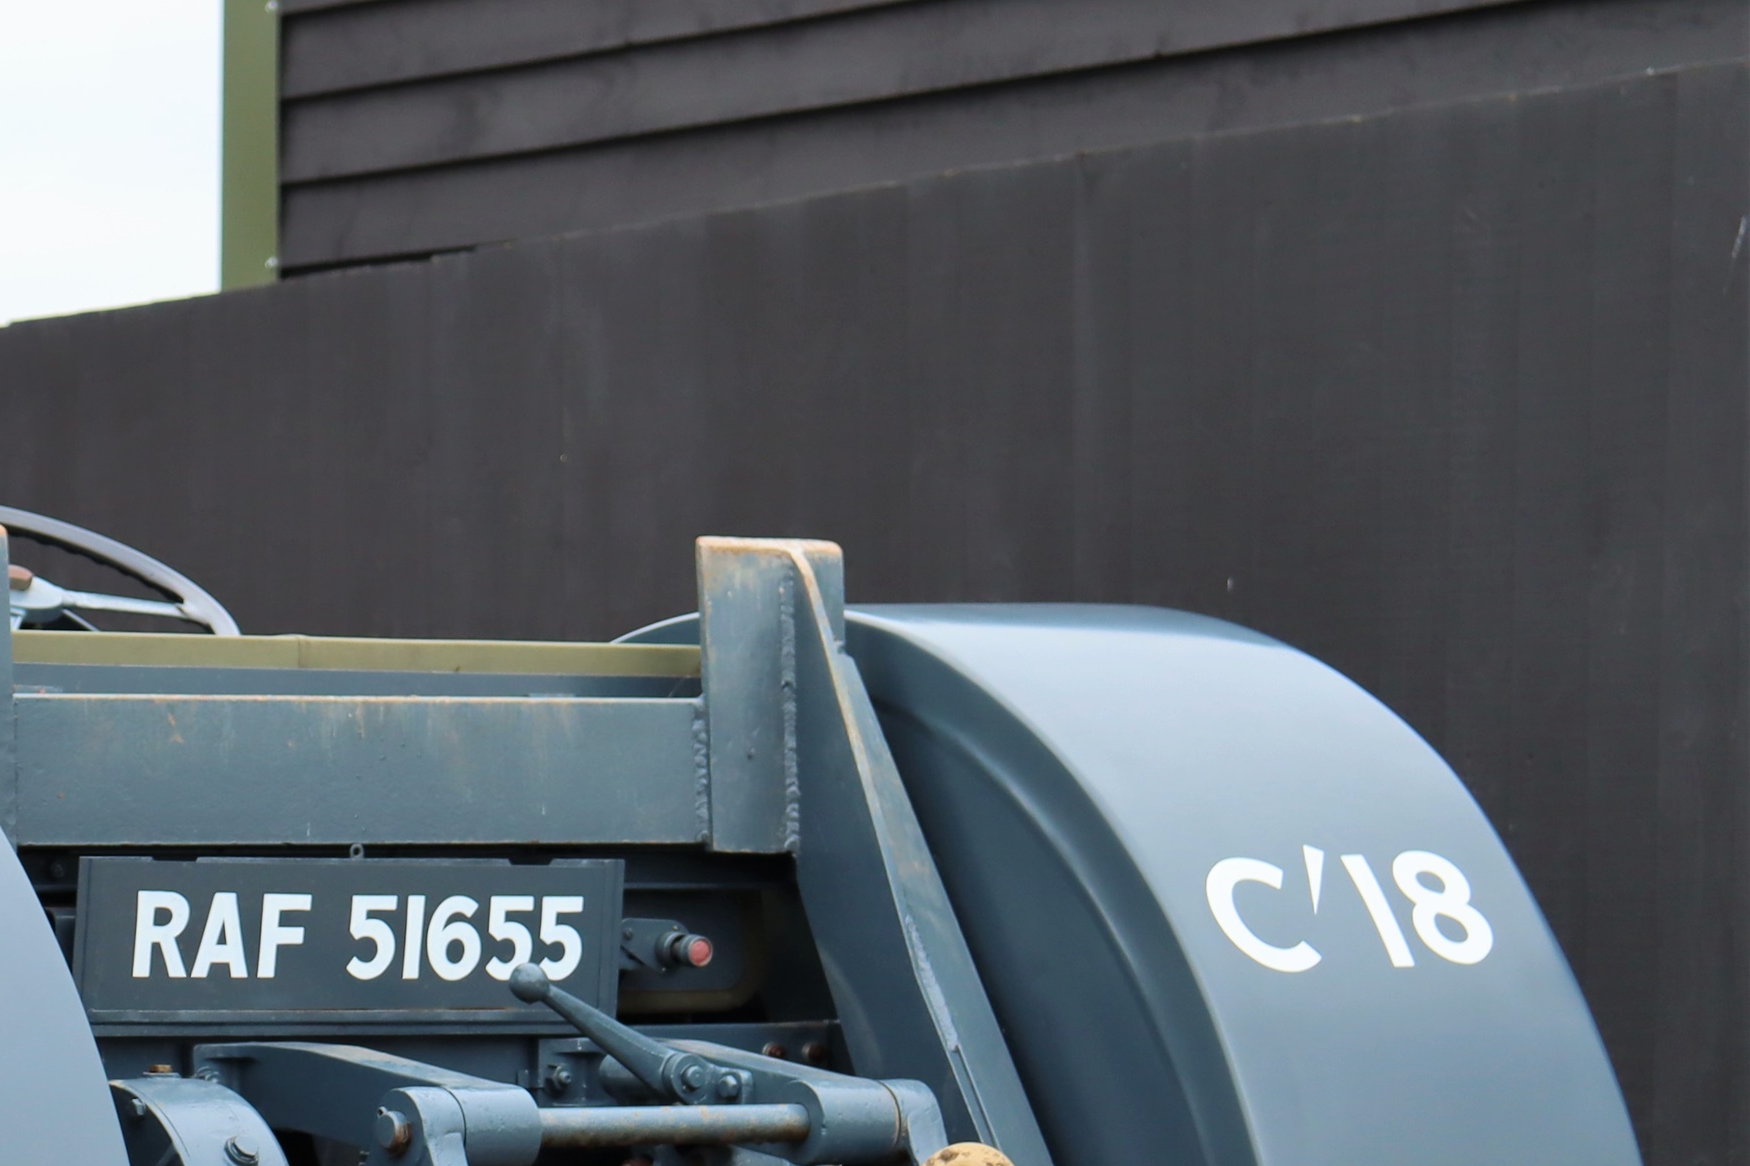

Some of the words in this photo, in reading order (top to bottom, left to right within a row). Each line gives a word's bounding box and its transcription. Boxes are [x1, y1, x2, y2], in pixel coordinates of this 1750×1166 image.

[131, 890, 313, 980] RAF
[345, 894, 585, 981] 51655
[1205, 844, 1494, 973] C'18
